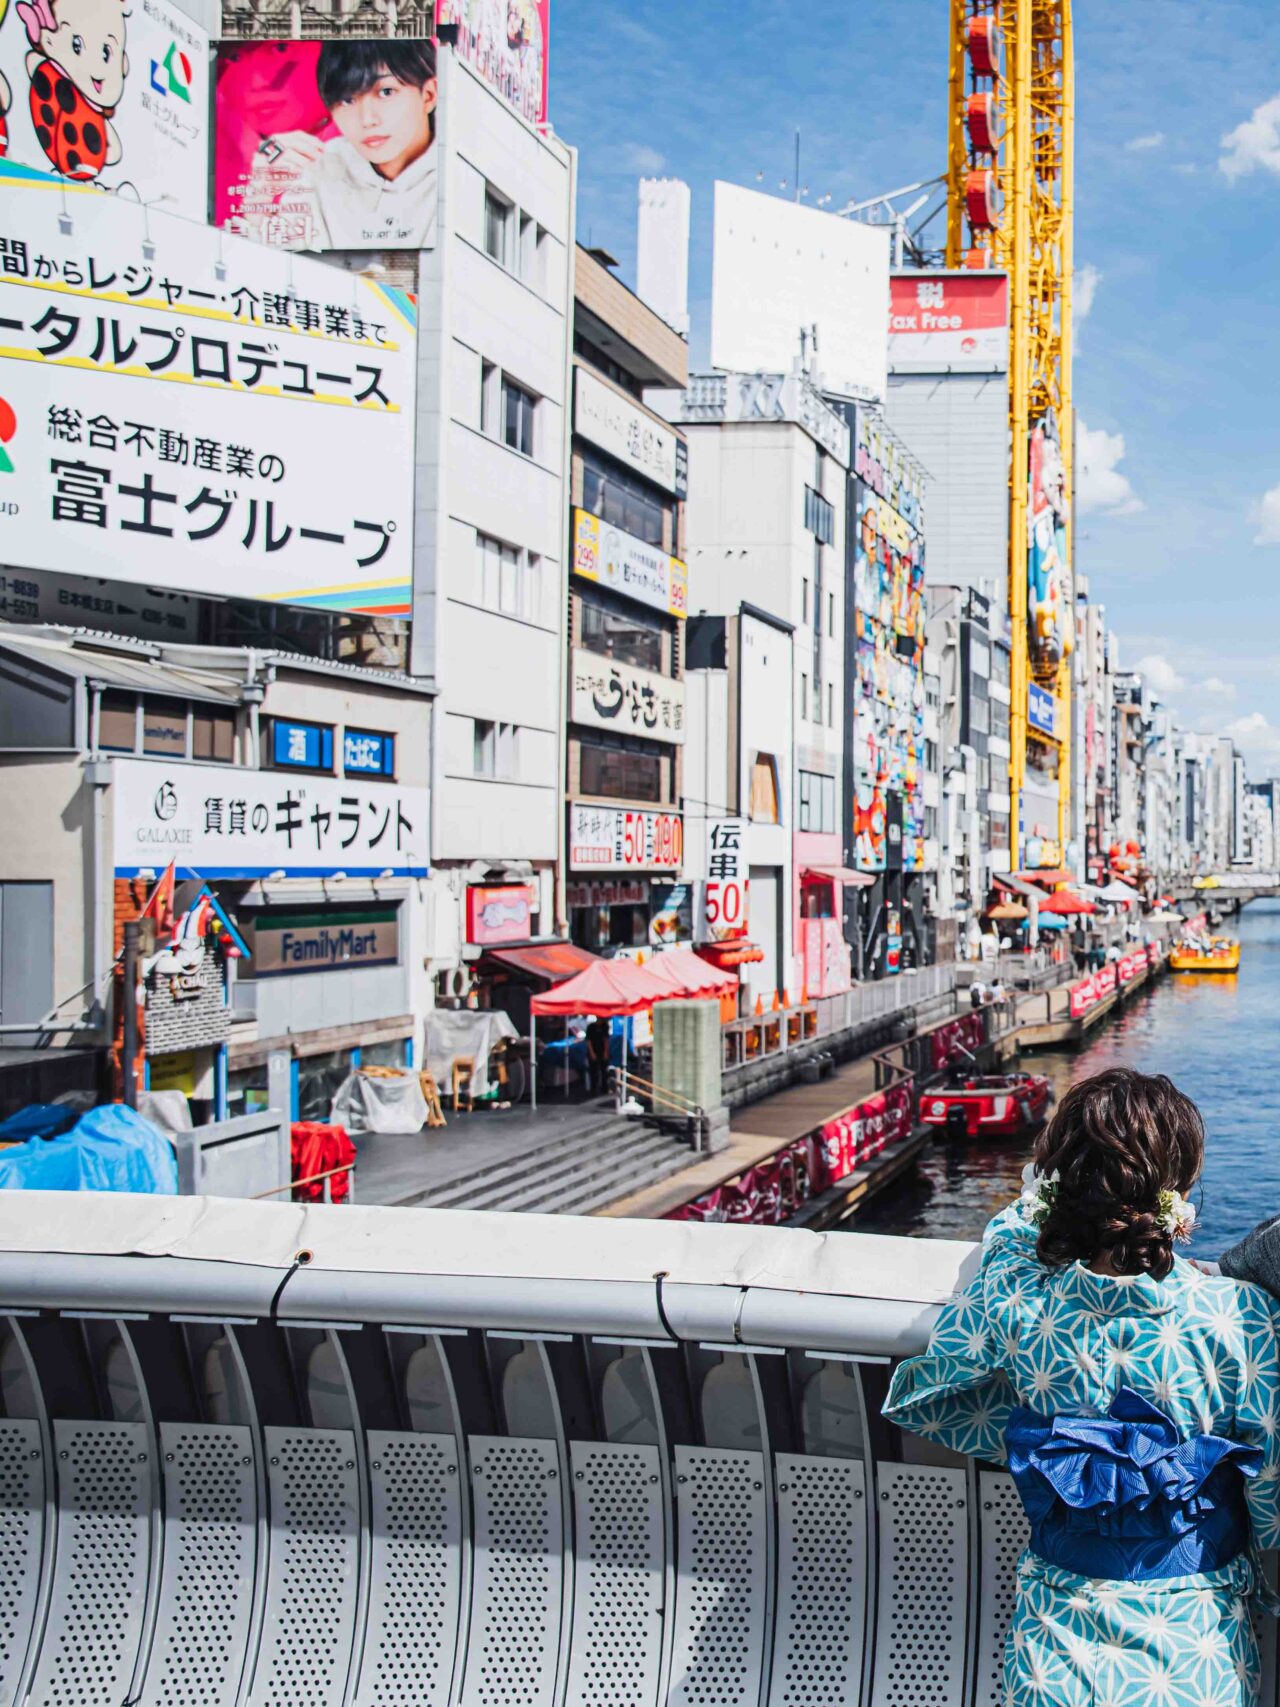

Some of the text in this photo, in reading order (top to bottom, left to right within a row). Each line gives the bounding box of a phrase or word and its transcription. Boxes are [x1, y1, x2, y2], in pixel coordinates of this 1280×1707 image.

[141, 91, 200, 140] 富士グループ
[921, 312, 962, 329] Free
[47, 404, 285, 483] 総合不動産業の
[50, 458, 397, 568] 富士グループ
[593, 668, 659, 728] うなぎ
[288, 729, 306, 761] 酒
[344, 738, 381, 769] たばこ
[204, 790, 413, 851] 賃貸のギャラント
[624, 813, 645, 864] 50
[709, 824, 741, 880] 伝串
[705, 883, 740, 924] 50
[282, 929, 377, 963] FamilyMart
